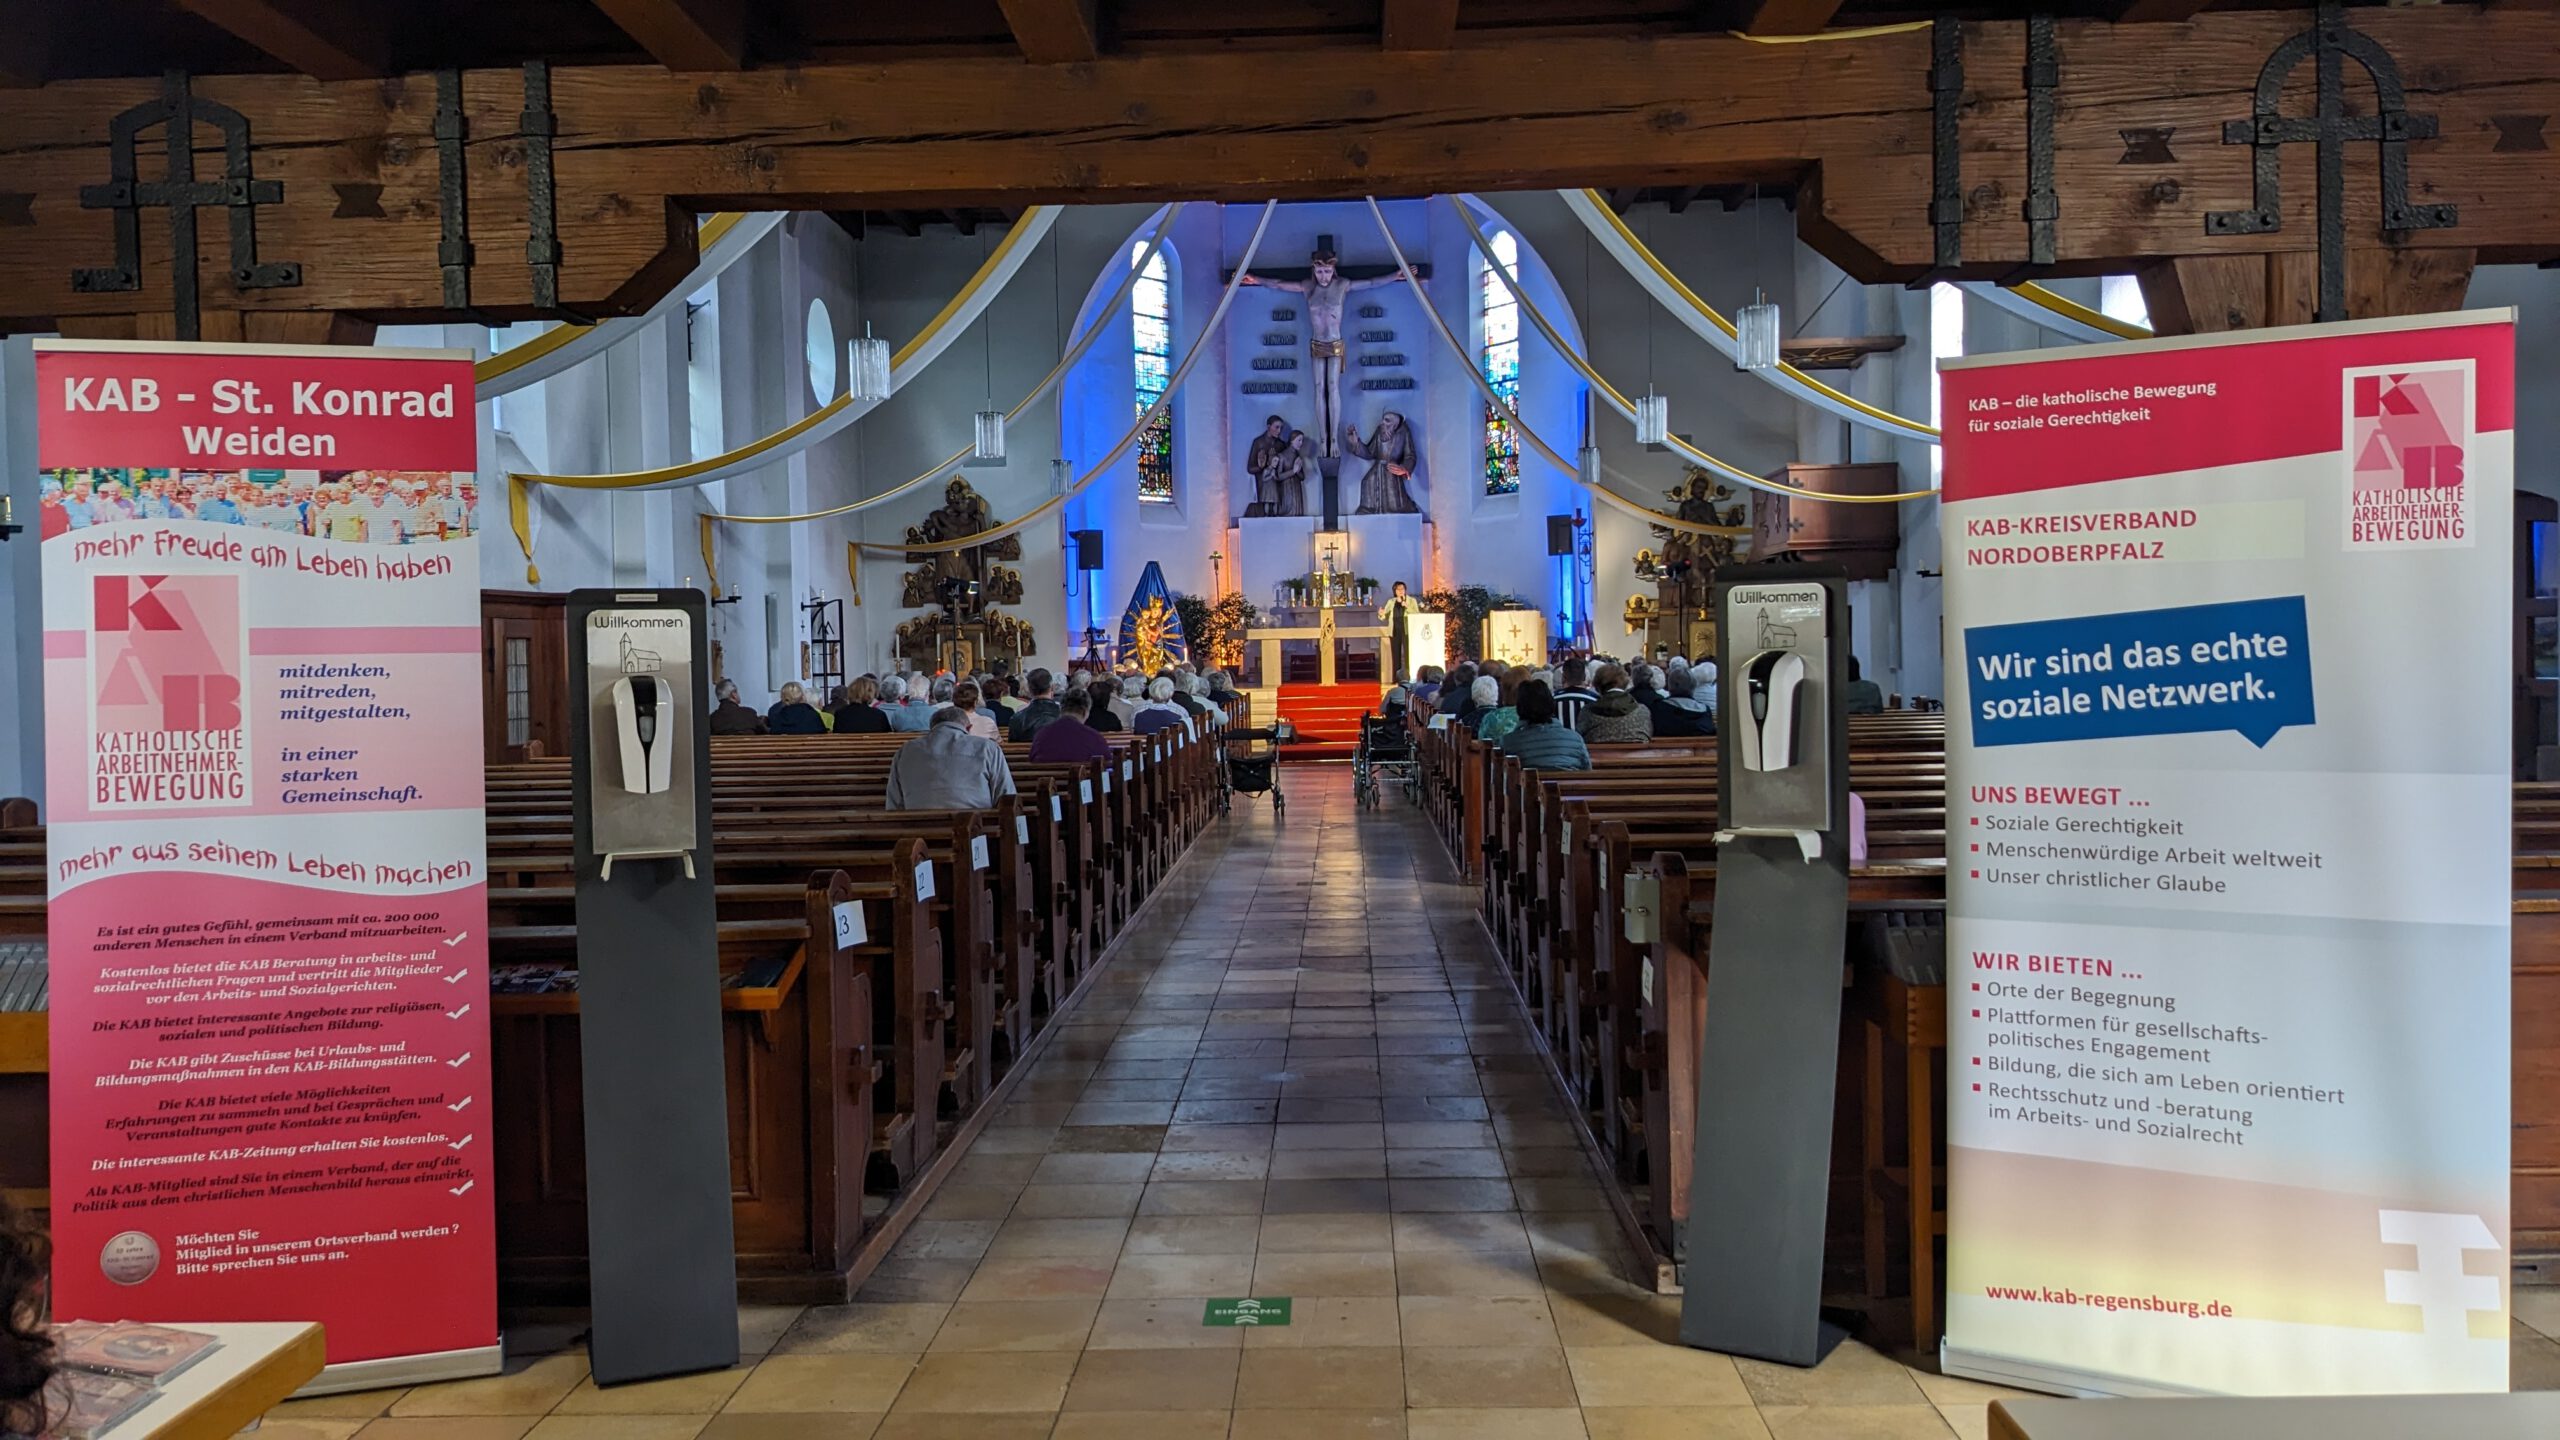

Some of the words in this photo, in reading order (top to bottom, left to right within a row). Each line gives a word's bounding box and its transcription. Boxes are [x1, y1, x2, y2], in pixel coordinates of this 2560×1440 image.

[64, 377, 160, 411] KAB
[211, 379, 274, 414] St.
[292, 381, 454, 418] Konrad
[1969, 398, 1999, 411] KAB
[2015, 394, 2038, 409] die
[2042, 388, 2130, 406] katholische
[2133, 382, 2217, 399] Bewegung
[1968, 418, 1989, 432] für
[1993, 415, 2044, 431] soziale
[2048, 407, 2151, 428] Gerechtigkeit
[182, 426, 336, 457] Weiden
[2353, 486, 2464, 506] KATHOLISCHE
[1967, 510, 2197, 537] KAB-KREISVERBAND
[2352, 503, 2464, 521] ARBEITNEHMER-
[2352, 519, 2464, 542] BEWEGUNG
[74, 531, 145, 564] mehr
[153, 528, 243, 562] Freude
[250, 544, 287, 569] am
[296, 547, 368, 580] Leben
[376, 552, 452, 582] haben
[1967, 541, 2165, 566] NORDOBERPFALZ
[1734, 591, 1818, 604] Willkommen
[594, 616, 683, 629] Willkommen
[1977, 652, 2036, 681] Wir
[2045, 644, 2113, 677] sind
[2122, 641, 2181, 669] das
[2190, 632, 2288, 664] echte
[279, 662, 391, 681] mitdenken,
[279, 683, 377, 701] mitreden,
[1982, 687, 2091, 720] soziale
[2101, 672, 2276, 712] Netzwerk.
[279, 703, 411, 722] mitgestalten,
[96, 729, 243, 753] KATHOLISCHE
[96, 750, 244, 775] ARBEITNEHMER-
[281, 748, 301, 762] in
[306, 747, 359, 761] einer
[281, 766, 359, 782] starken
[97, 772, 244, 804] BEWEGUNG
[281, 785, 423, 804] Gemeinschaft.
[1970, 785, 2018, 804] UNS
[2024, 787, 2122, 805] BEWEGT
[1985, 815, 2049, 831] Soziale
[2055, 816, 2184, 838] Gerechtigkeit
[59, 842, 123, 882] mehr
[132, 840, 179, 862] aus
[188, 839, 278, 871] seinem
[288, 851, 366, 884] Leben
[374, 858, 472, 887] machen
[1986, 842, 2159, 865] Menschenwürdige
[2165, 847, 2226, 866] Arbeit
[2232, 850, 2323, 870] weltweit
[1986, 868, 2041, 885] Unser
[2046, 870, 2151, 890] christlicher
[2156, 874, 2227, 893] Glaube
[97, 926, 113, 937] Es
[117, 925, 134, 936] ist
[137, 924, 159, 935] ein
[162, 923, 200, 936] gutes
[256, 916, 335, 933] gemeinsam
[336, 914, 359, 925] mit
[362, 915, 381, 924] ca.
[384, 914, 410, 923] 200
[413, 912, 440, 921] 000
[93, 939, 151, 951] anderen
[154, 935, 224, 949] Menschen
[228, 934, 241, 944] in
[244, 932, 285, 944] einem
[289, 928, 347, 942] Verband
[350, 925, 447, 938] mitzuarbeiten.
[100, 964, 170, 979] Kostenlos
[173, 962, 212, 974] bietet
[215, 960, 237, 972] die
[239, 959, 269, 971] KAB
[272, 956, 337, 970] Beratung
[340, 954, 353, 964] in
[356, 952, 407, 964] arbeits-
[410, 949, 437, 961] und
[1972, 951, 2020, 971] WIR
[2028, 954, 2114, 977] BIETEN
[93, 977, 213, 994] sozialrechtlichen
[216, 975, 265, 989] Fragen
[268, 970, 295, 983] und
[298, 968, 348, 981] vertritt
[350, 966, 371, 978] die
[374, 964, 443, 978] Mitglieder
[1987, 981, 2028, 999] Orte
[2033, 983, 2065, 1002] der
[2070, 986, 2176, 1013] Begegnung
[1987, 1008, 2097, 1032] Plattformen
[2102, 1015, 2129, 1033] für
[2135, 1020, 2269, 1046] gesellschafts-
[128, 1058, 154, 1070] Die
[156, 1056, 187, 1068] KAB
[189, 1054, 218, 1068] gibt
[220, 1050, 291, 1063] Zuschüsse
[294, 1046, 315, 1058] bei
[318, 1043, 377, 1056] Urlaubs-
[379, 1041, 406, 1052] und
[1987, 1030, 2085, 1053] politisches
[2090, 1037, 2211, 1065] Engagement
[95, 1068, 245, 1087] Bildungsmaßnahmen
[247, 1066, 262, 1077] in
[264, 1063, 290, 1075] den
[293, 1054, 437, 1073] KAB-Bildungsstätten.
[1987, 1055, 2062, 1080] Bildung,
[2067, 1060, 2097, 1080] die
[2101, 1064, 2139, 1085] sich
[2144, 1073, 2174, 1088] am
[2180, 1073, 2240, 1095] Leben
[2246, 1081, 2346, 1105] orientiert
[1988, 1082, 2108, 1108] Rechtsschutz
[2114, 1094, 2150, 1113] und
[2155, 1098, 2254, 1126] -beratung
[1988, 1104, 2011, 1120] im
[2016, 1106, 2090, 1128] Arbeits-
[2095, 1114, 2131, 1133] und
[2136, 1119, 2244, 1147] Sozialrecht
[91, 1159, 116, 1171] Die
[118, 1152, 205, 1169] interessante
[208, 1145, 296, 1161] KAB-Zeitung
[299, 1140, 357, 1153] erhalten
[359, 1137, 381, 1148] Sie
[383, 1132, 449, 1147] kostenlos.
[176, 1231, 235, 1246] Möchten
[238, 1229, 260, 1240] Sie
[176, 1247, 233, 1262] Mitglied
[235, 1245, 249, 1255] in
[252, 1240, 312, 1254] unserem
[314, 1229, 398, 1247] Ortsverband
[400, 1225, 450, 1240] werden
[452, 1223, 461, 1235] ?
[176, 1262, 209, 1275] Bitte
[212, 1257, 274, 1274] sprechen
[276, 1253, 298, 1266] Sie
[301, 1252, 324, 1263] uns
[327, 1251, 351, 1261] an.
[1986, 1285, 2233, 1320] www.kab-regensburg.de
